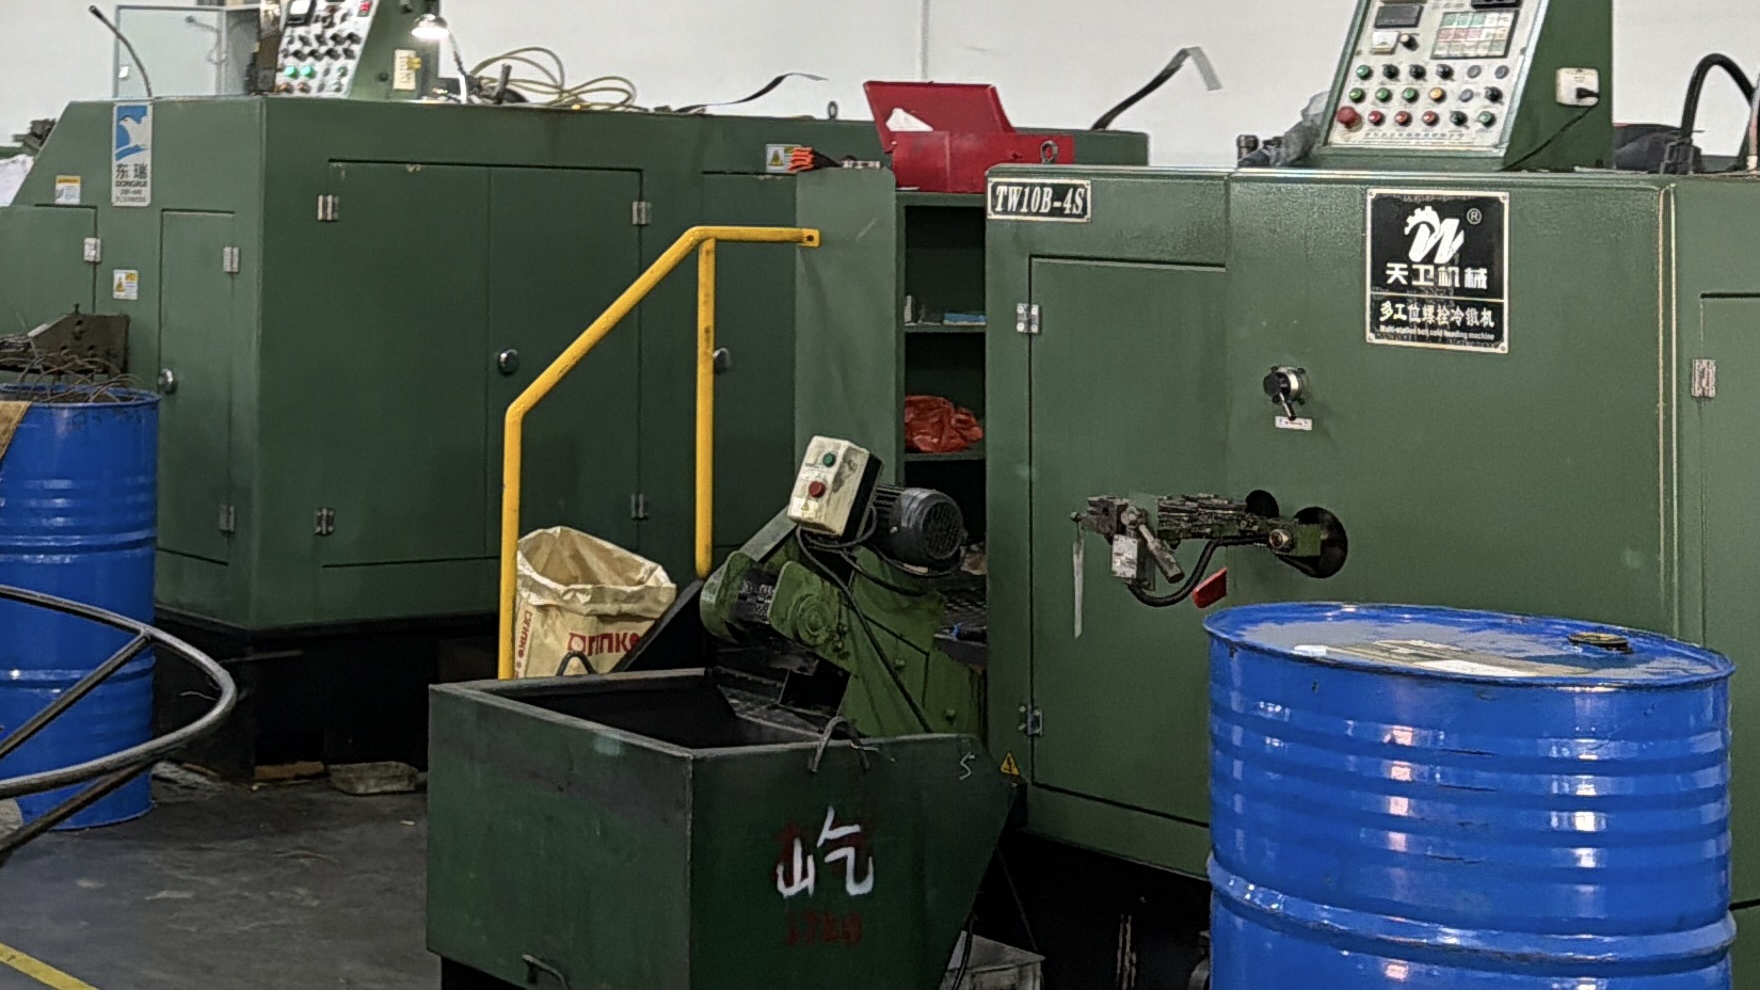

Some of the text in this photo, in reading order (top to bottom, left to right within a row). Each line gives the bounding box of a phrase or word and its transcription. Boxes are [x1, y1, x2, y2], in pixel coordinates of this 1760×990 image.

[995, 185, 1086, 215] TW10B-4S
[1385, 262, 1488, 289] 天卫机械
